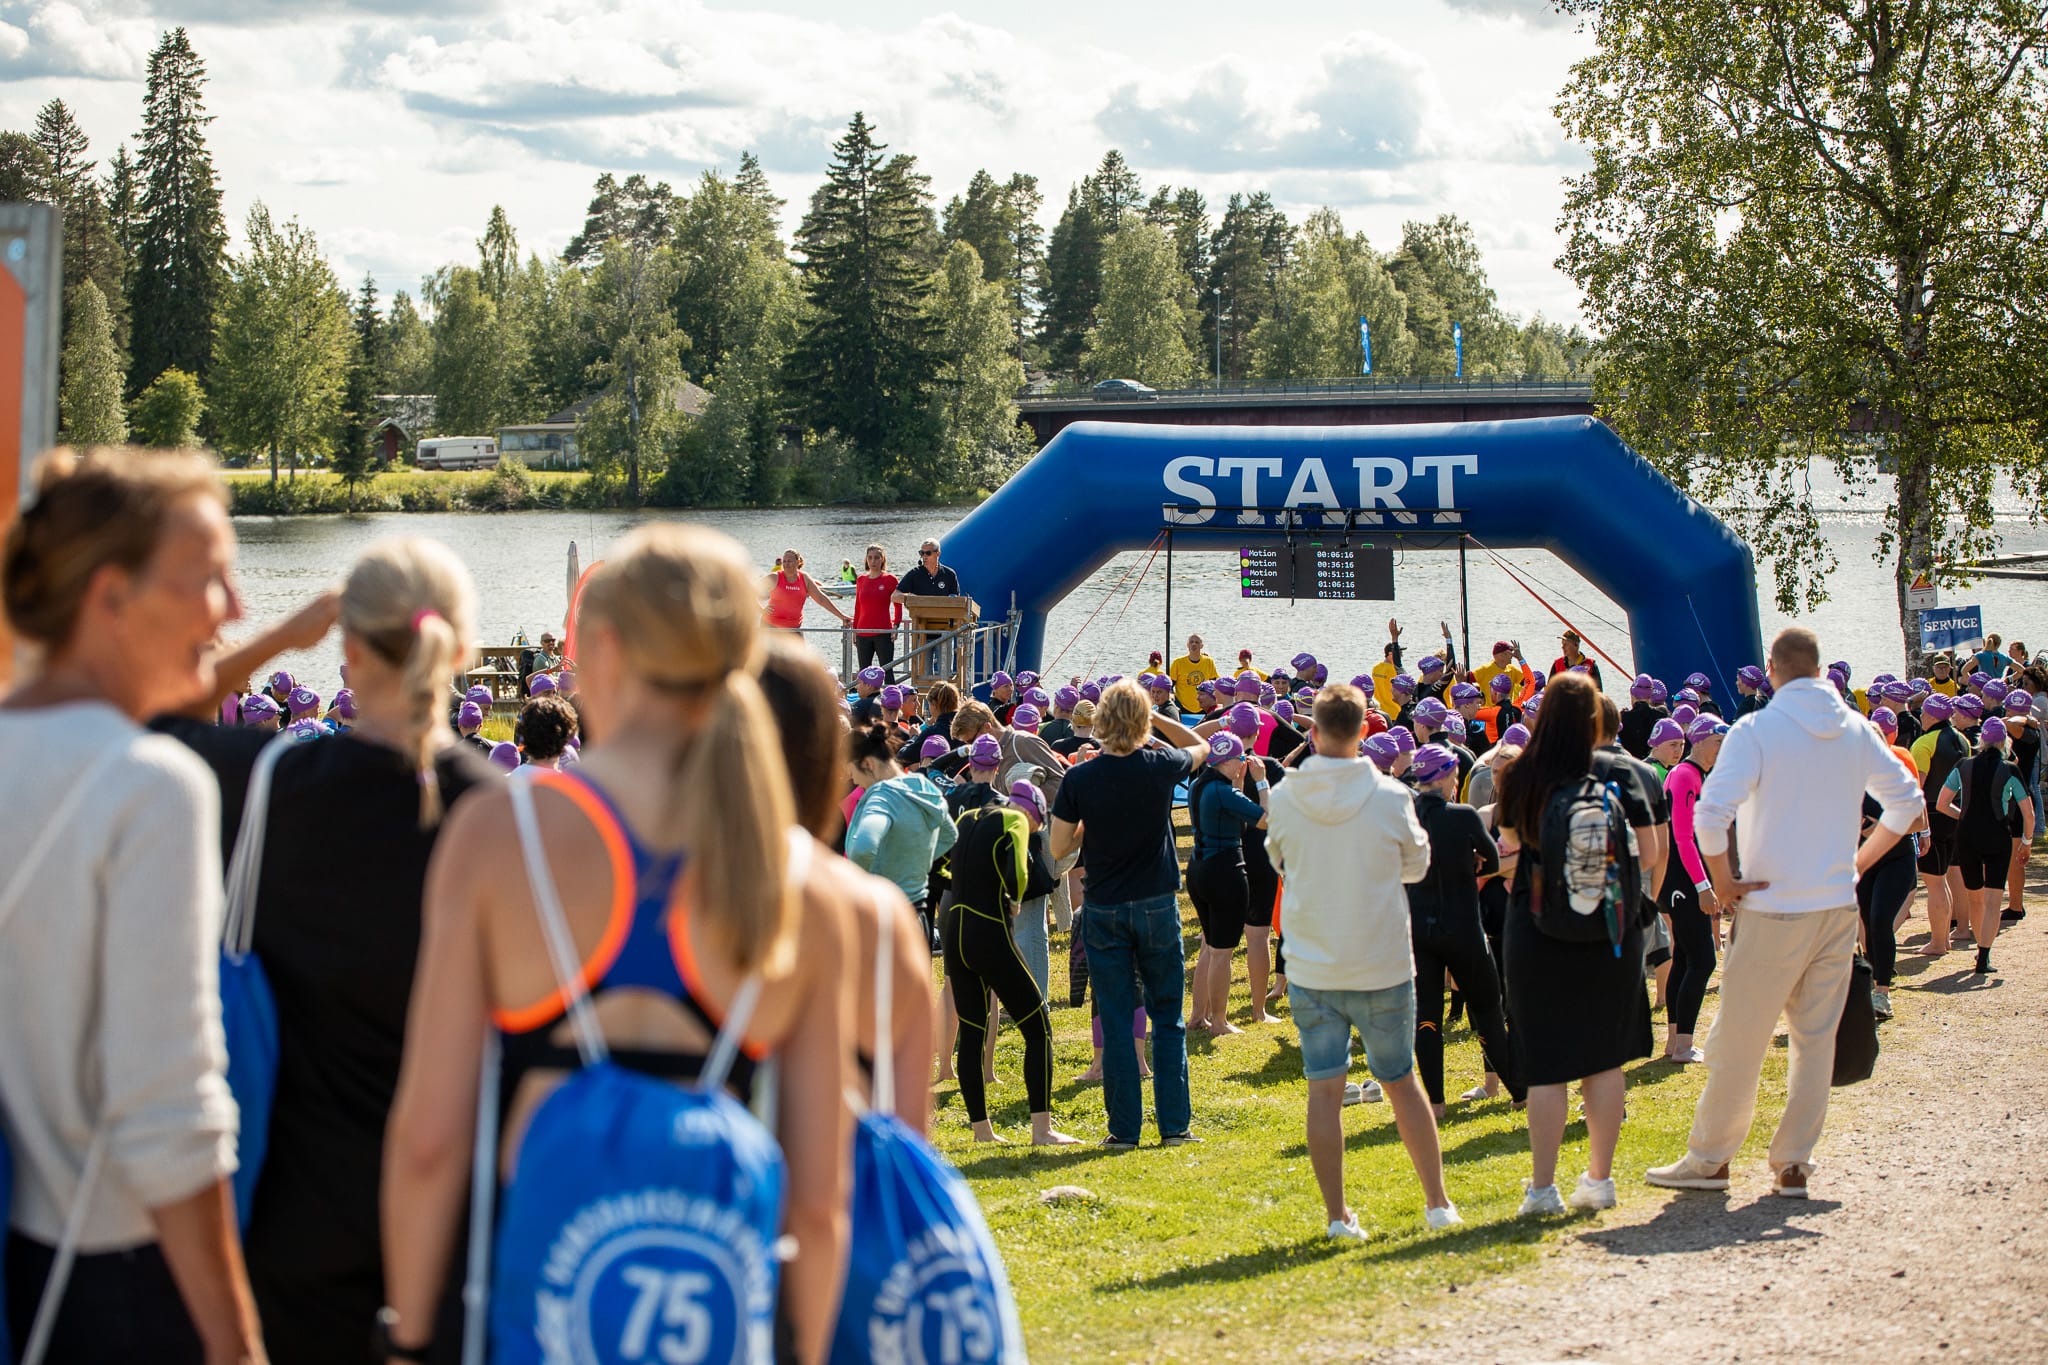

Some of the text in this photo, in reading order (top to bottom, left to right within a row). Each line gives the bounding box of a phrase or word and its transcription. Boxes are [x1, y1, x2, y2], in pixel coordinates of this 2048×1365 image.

[1162, 455, 1478, 525] START
[1249, 549, 1354, 559] Motion 00:06:16
[1249, 559, 1354, 569] Motion 00:36:16
[1249, 569, 1355, 578] Motion 00:51:16
[1250, 589, 1356, 598] Motion 01:21:16
[1924, 617, 1978, 632] SERVICE
[620, 1264, 714, 1365] 75
